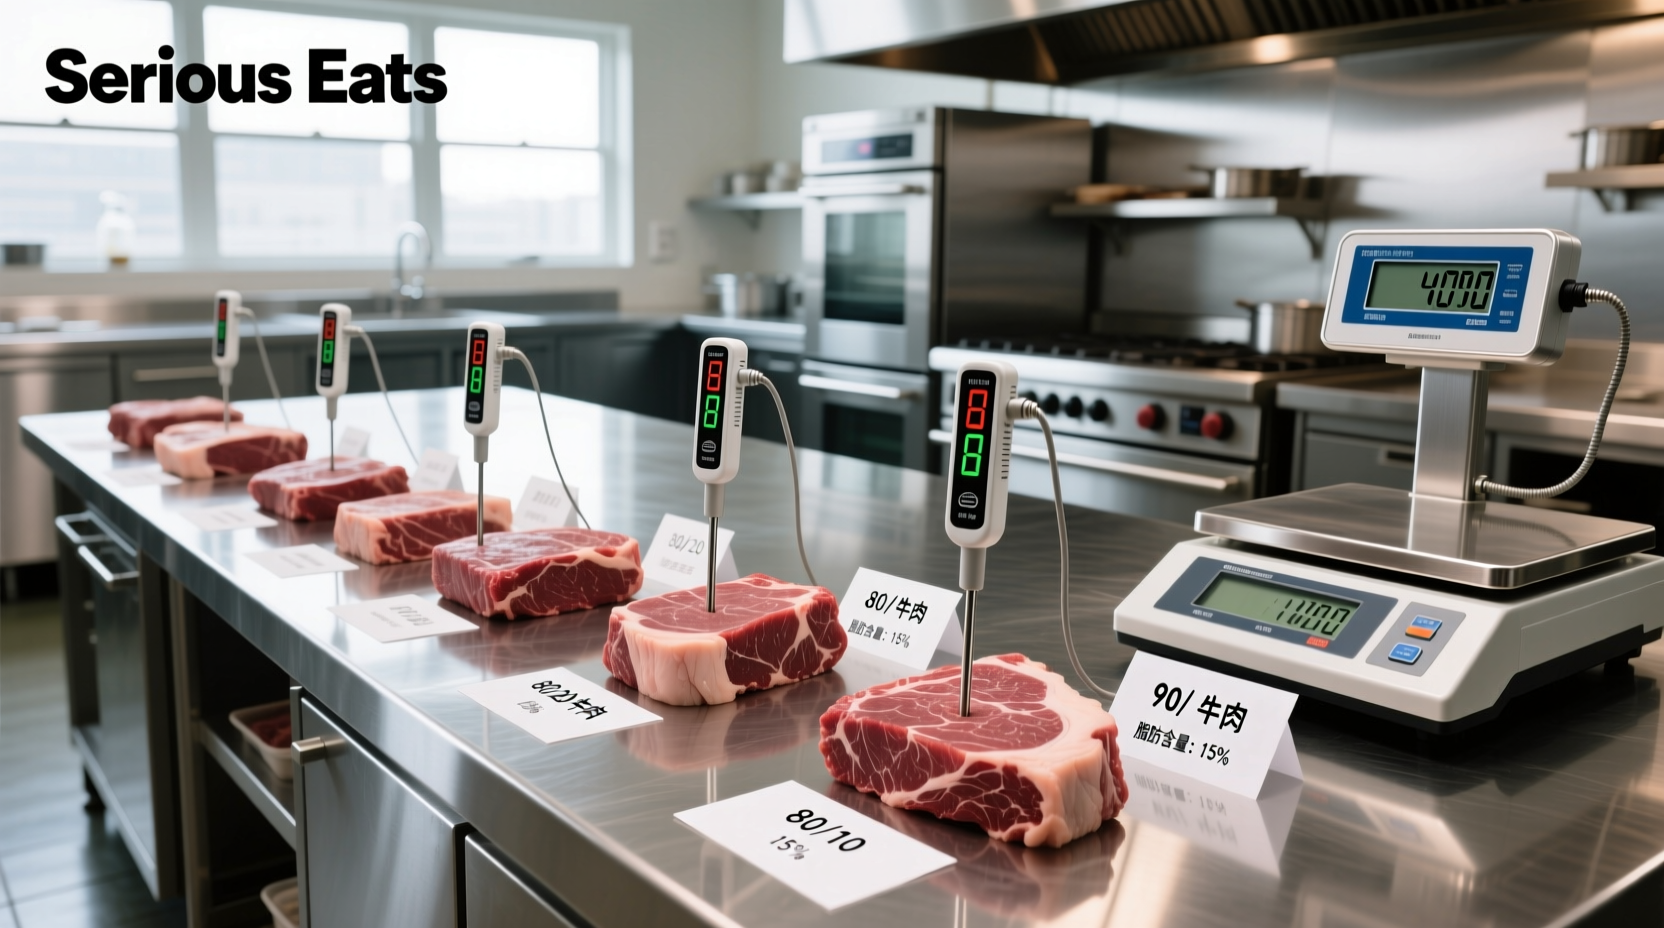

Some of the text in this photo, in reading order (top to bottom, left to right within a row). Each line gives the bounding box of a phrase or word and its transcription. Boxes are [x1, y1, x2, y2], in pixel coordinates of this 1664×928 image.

[1197, 694, 1248, 734] 牛肉
[1200, 742, 1230, 766] 15%
[785, 808, 867, 852] 80/10
